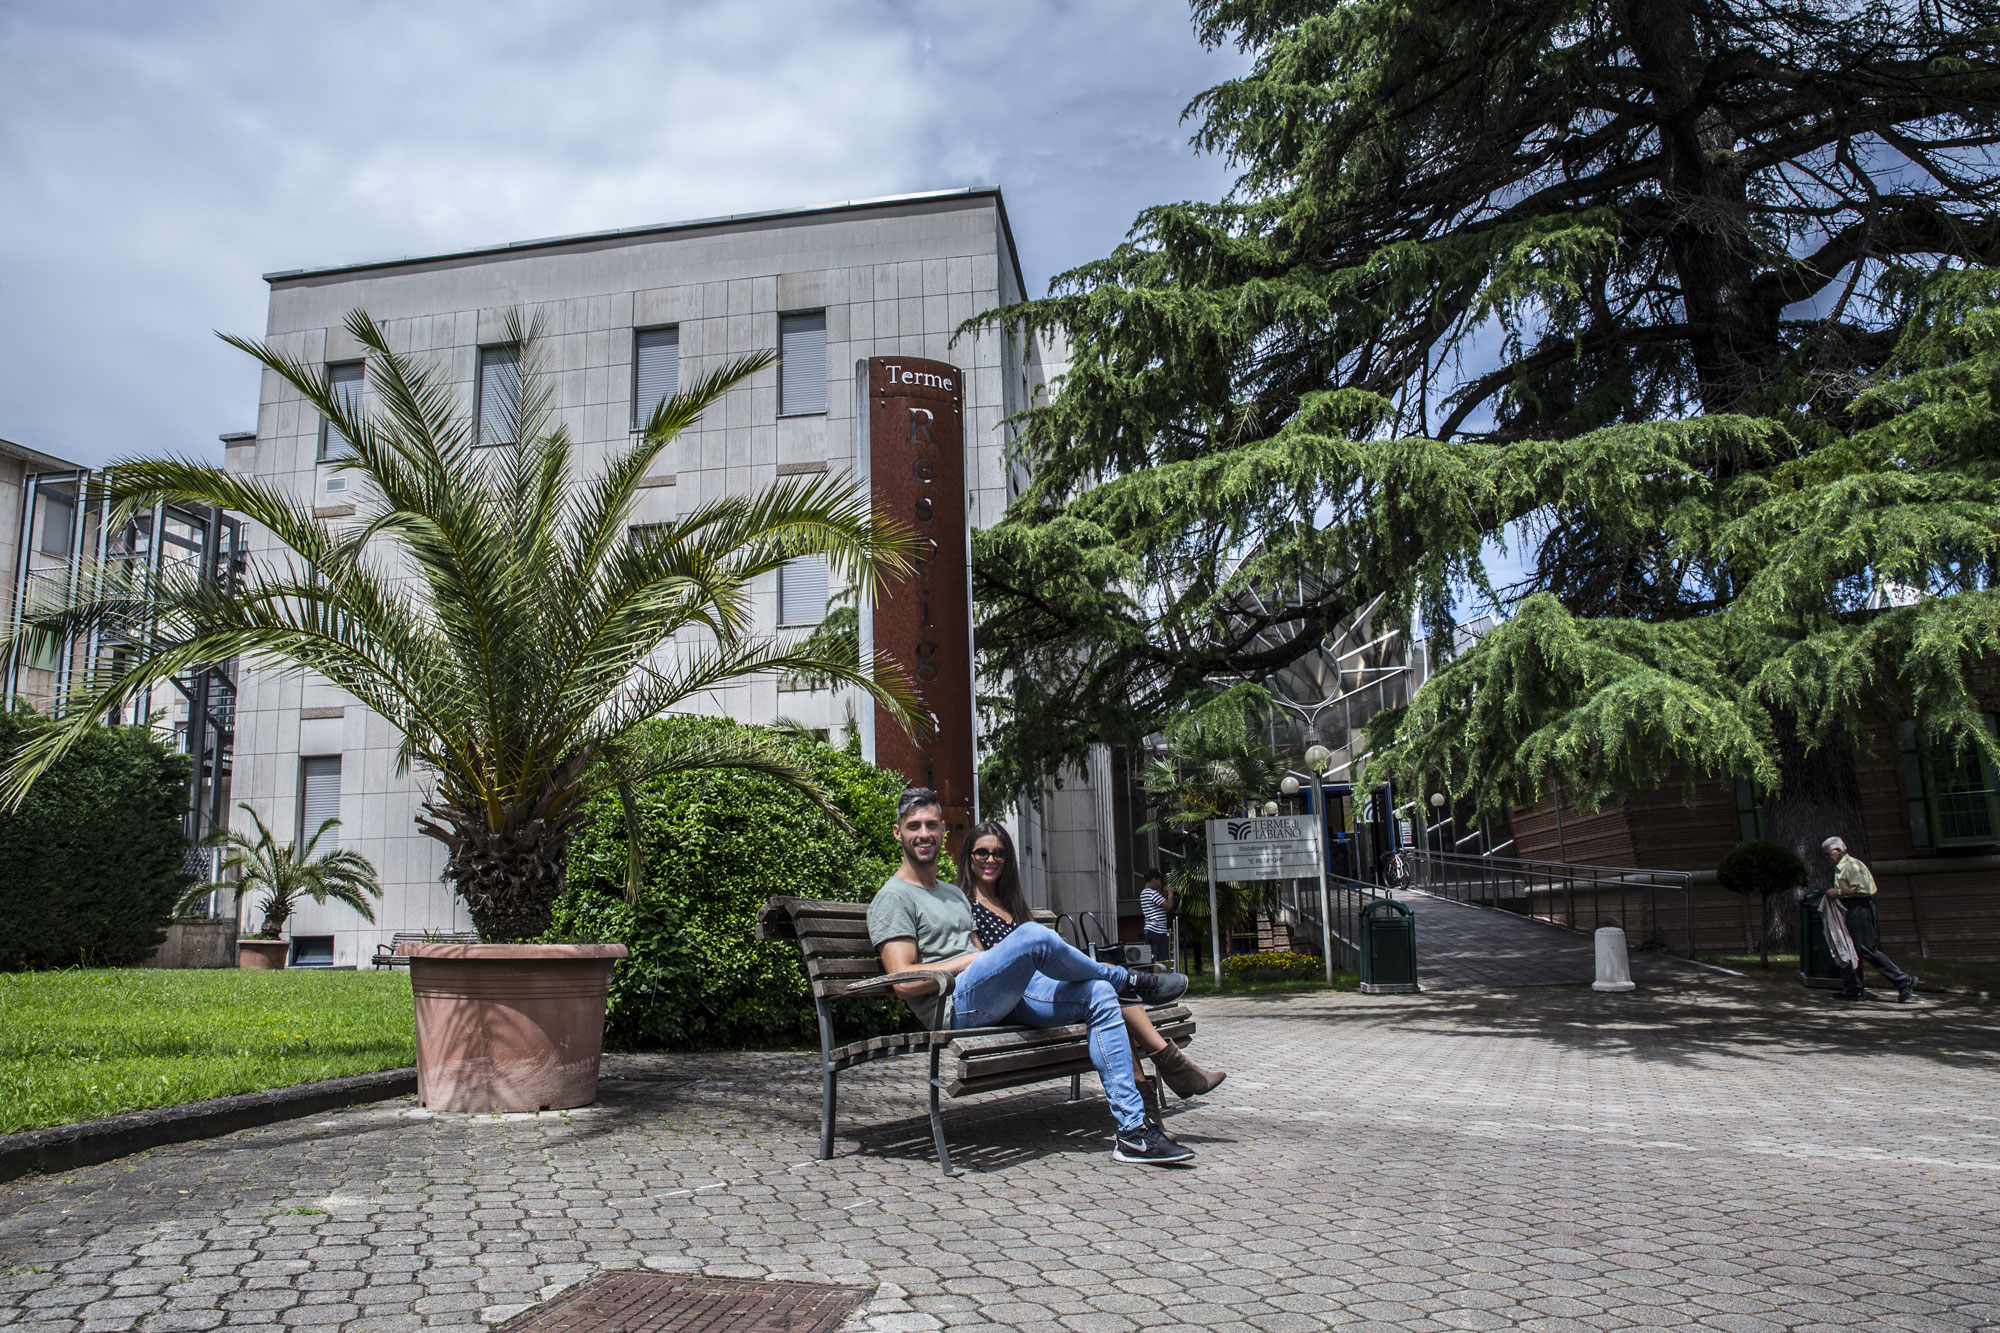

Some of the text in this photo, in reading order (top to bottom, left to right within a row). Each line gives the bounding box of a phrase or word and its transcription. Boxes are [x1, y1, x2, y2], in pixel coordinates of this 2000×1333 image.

[885, 365, 953, 392] Terme
[1252, 819, 1299, 829] TERME di
[1253, 828, 1301, 839] TABIANO
